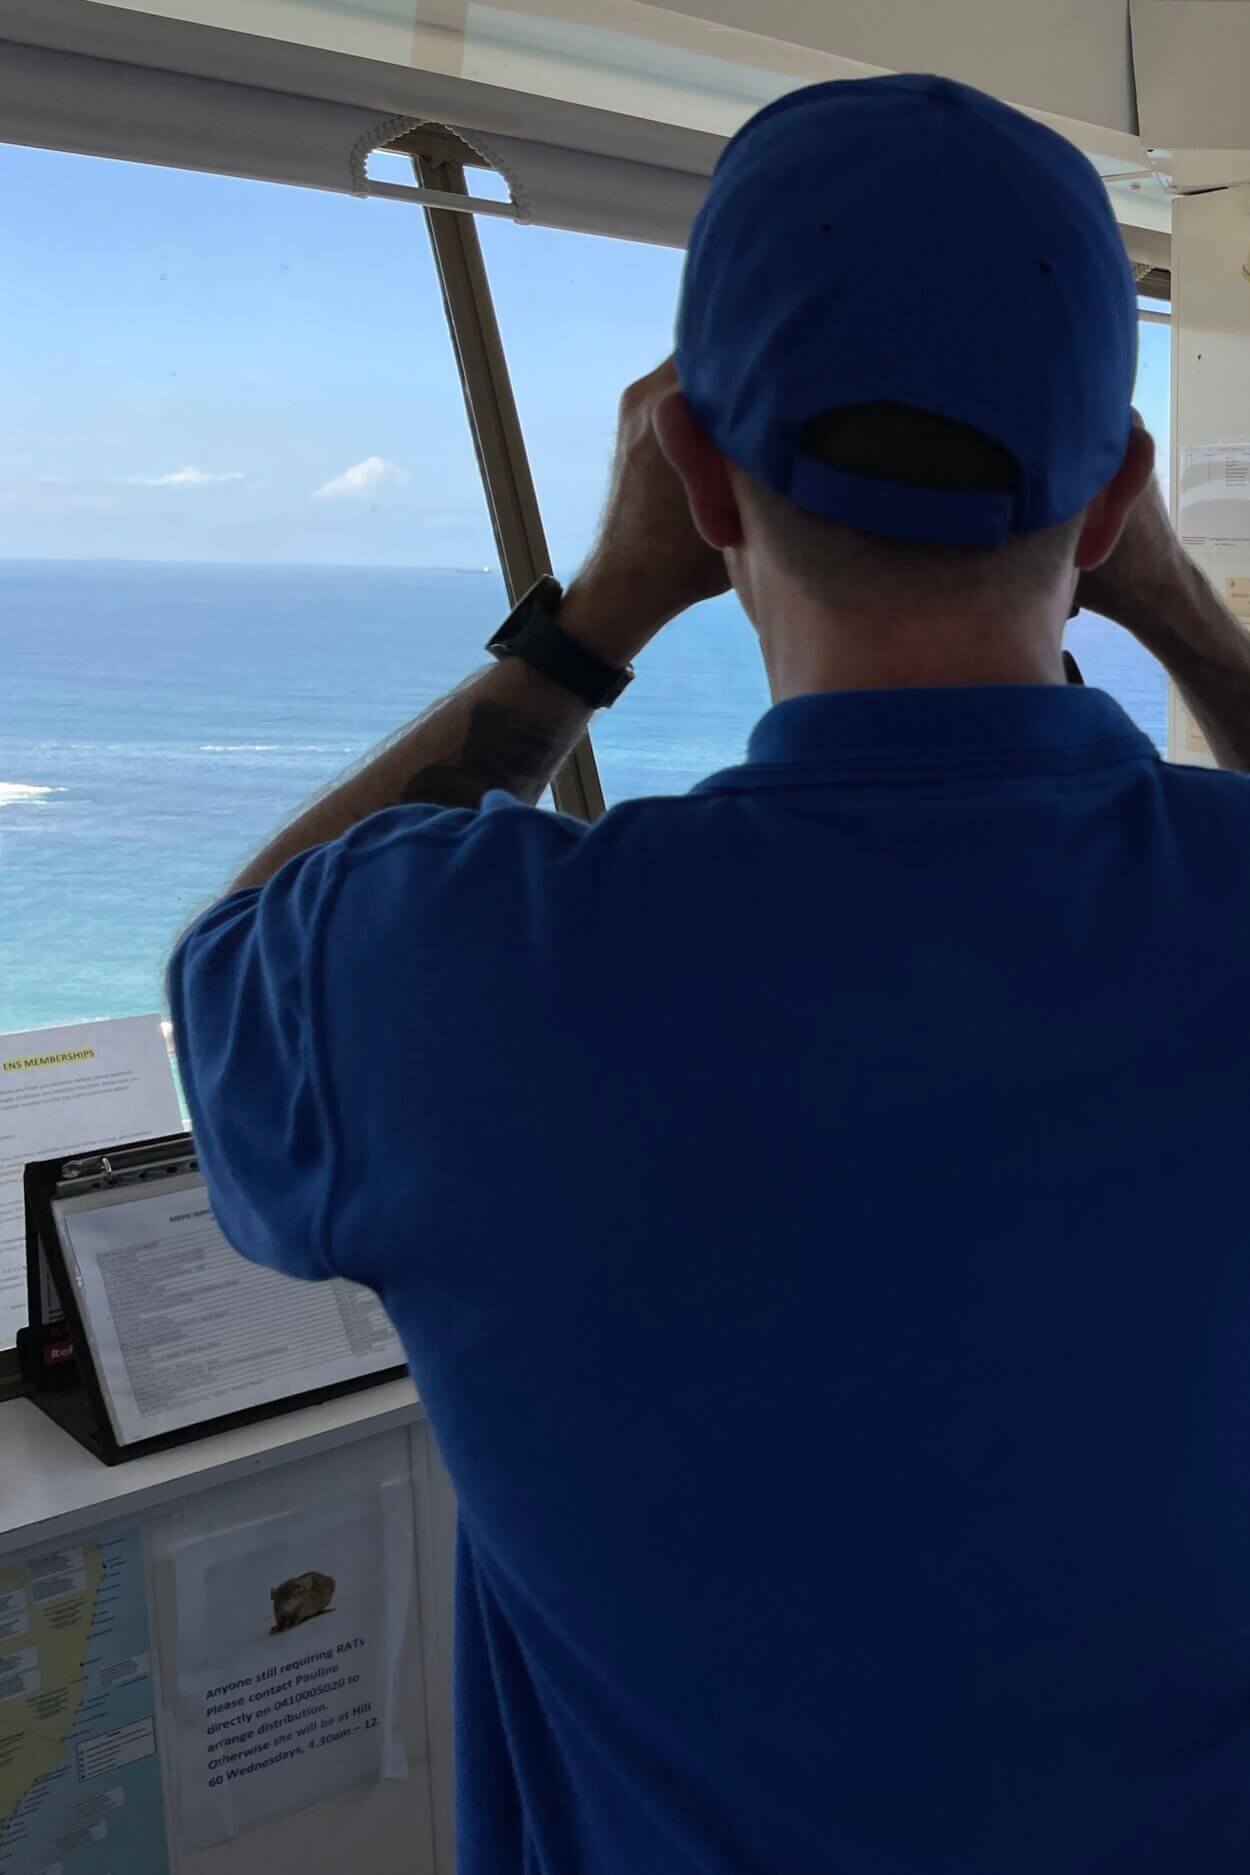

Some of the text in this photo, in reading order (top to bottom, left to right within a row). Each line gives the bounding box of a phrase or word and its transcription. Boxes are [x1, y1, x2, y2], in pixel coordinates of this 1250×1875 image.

[24, 1049, 95, 1067] MEMBERSHIPS
[206, 1638, 365, 1700] Anyone still requiring RATs
[206, 1664, 339, 1717] Please contact Pauline
[207, 1712, 253, 1735] directly
[255, 1706, 271, 1718] on
[348, 1674, 360, 1684] to
[208, 1703, 328, 1753] arrange distribution.
[208, 1702, 371, 1770] Otherwise she will be at Hill
[209, 1775, 223, 1788] 60
